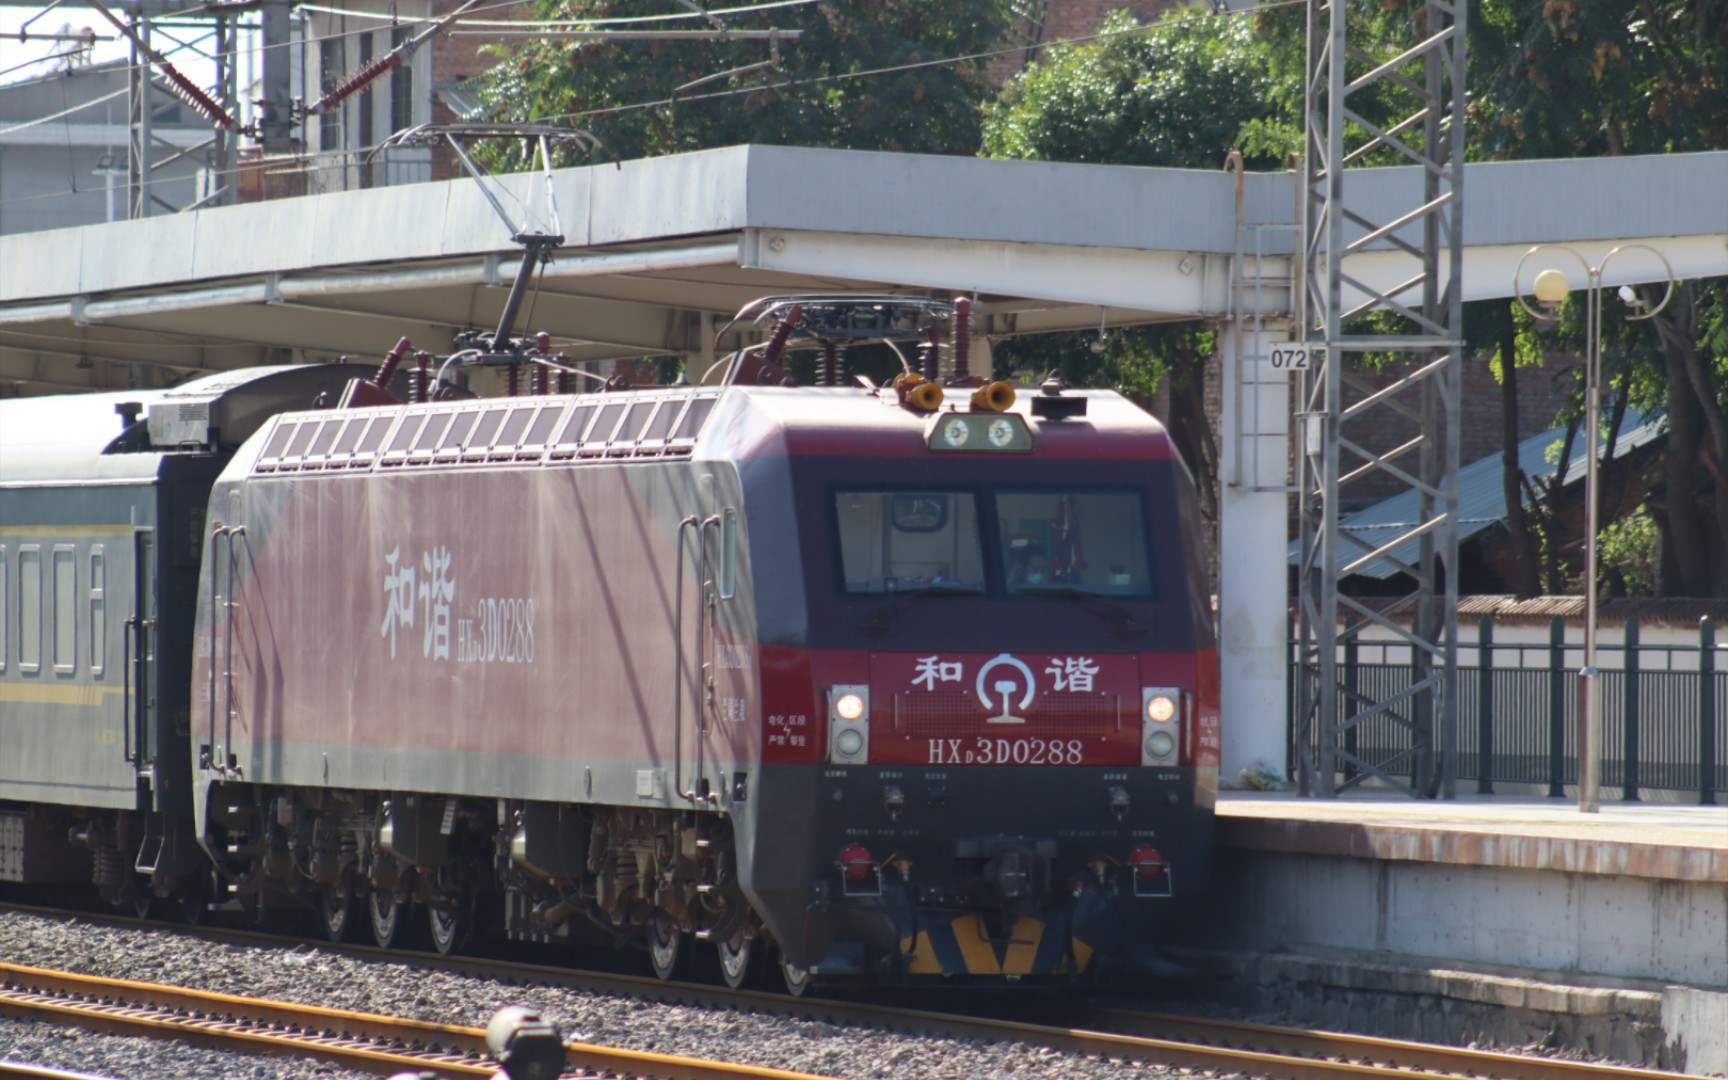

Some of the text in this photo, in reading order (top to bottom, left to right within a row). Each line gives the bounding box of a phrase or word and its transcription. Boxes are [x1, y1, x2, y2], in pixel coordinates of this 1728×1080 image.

[1272, 350, 1306, 368] 072
[381, 543, 455, 661] 和谐
[911, 656, 1100, 692] 和 谐
[928, 739, 1082, 765] HXD3D0288
